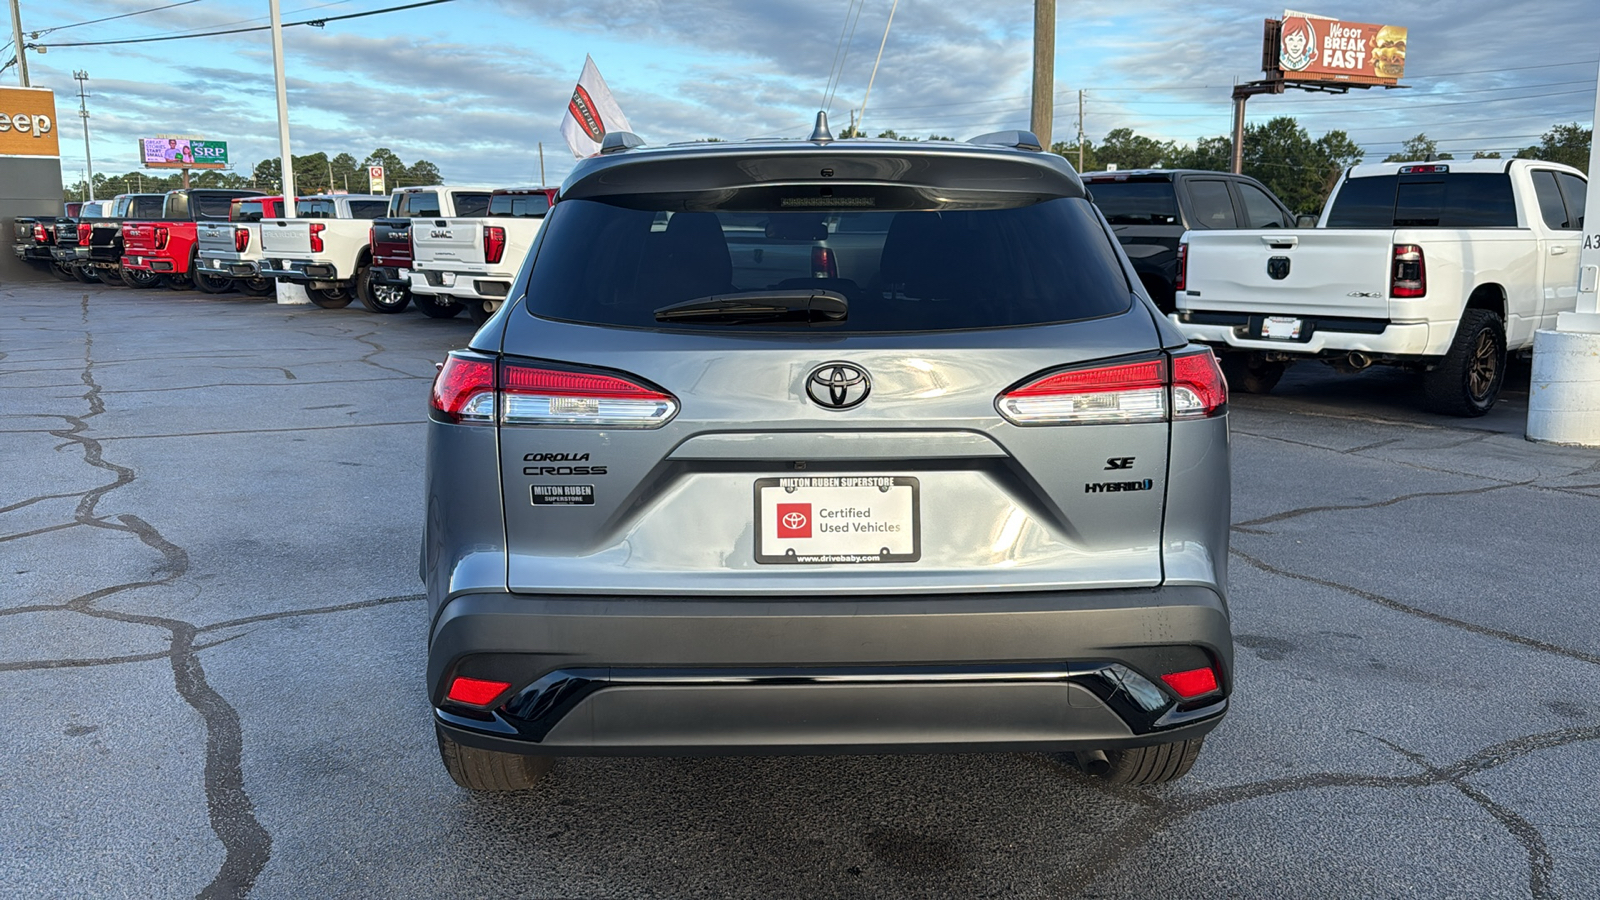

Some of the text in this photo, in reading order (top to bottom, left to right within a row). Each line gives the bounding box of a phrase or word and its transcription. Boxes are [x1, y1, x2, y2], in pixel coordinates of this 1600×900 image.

[1330, 22, 1342, 38] We
[1343, 28, 1362, 39] GOT
[1324, 36, 1366, 52] BREAK
[1322, 49, 1366, 70] FAST
[572, 92, 600, 135] ERTIFIED
[0, 113, 51, 137] eep
[194, 147, 225, 157] SRP
[430, 229, 454, 239] GMC
[523, 453, 590, 462] COROLLA
[1103, 456, 1136, 471] SE
[523, 465, 608, 476] CROSS
[779, 476, 895, 488] MILTON RUBEN SUPERSTORE
[1084, 481, 1143, 493] HYBRID
[533, 486, 592, 496] MILTON RUBEN
[819, 507, 871, 519] Certified
[819, 521, 901, 533] Used Vehicles
[796, 554, 880, 563] www.drivebaby.com
